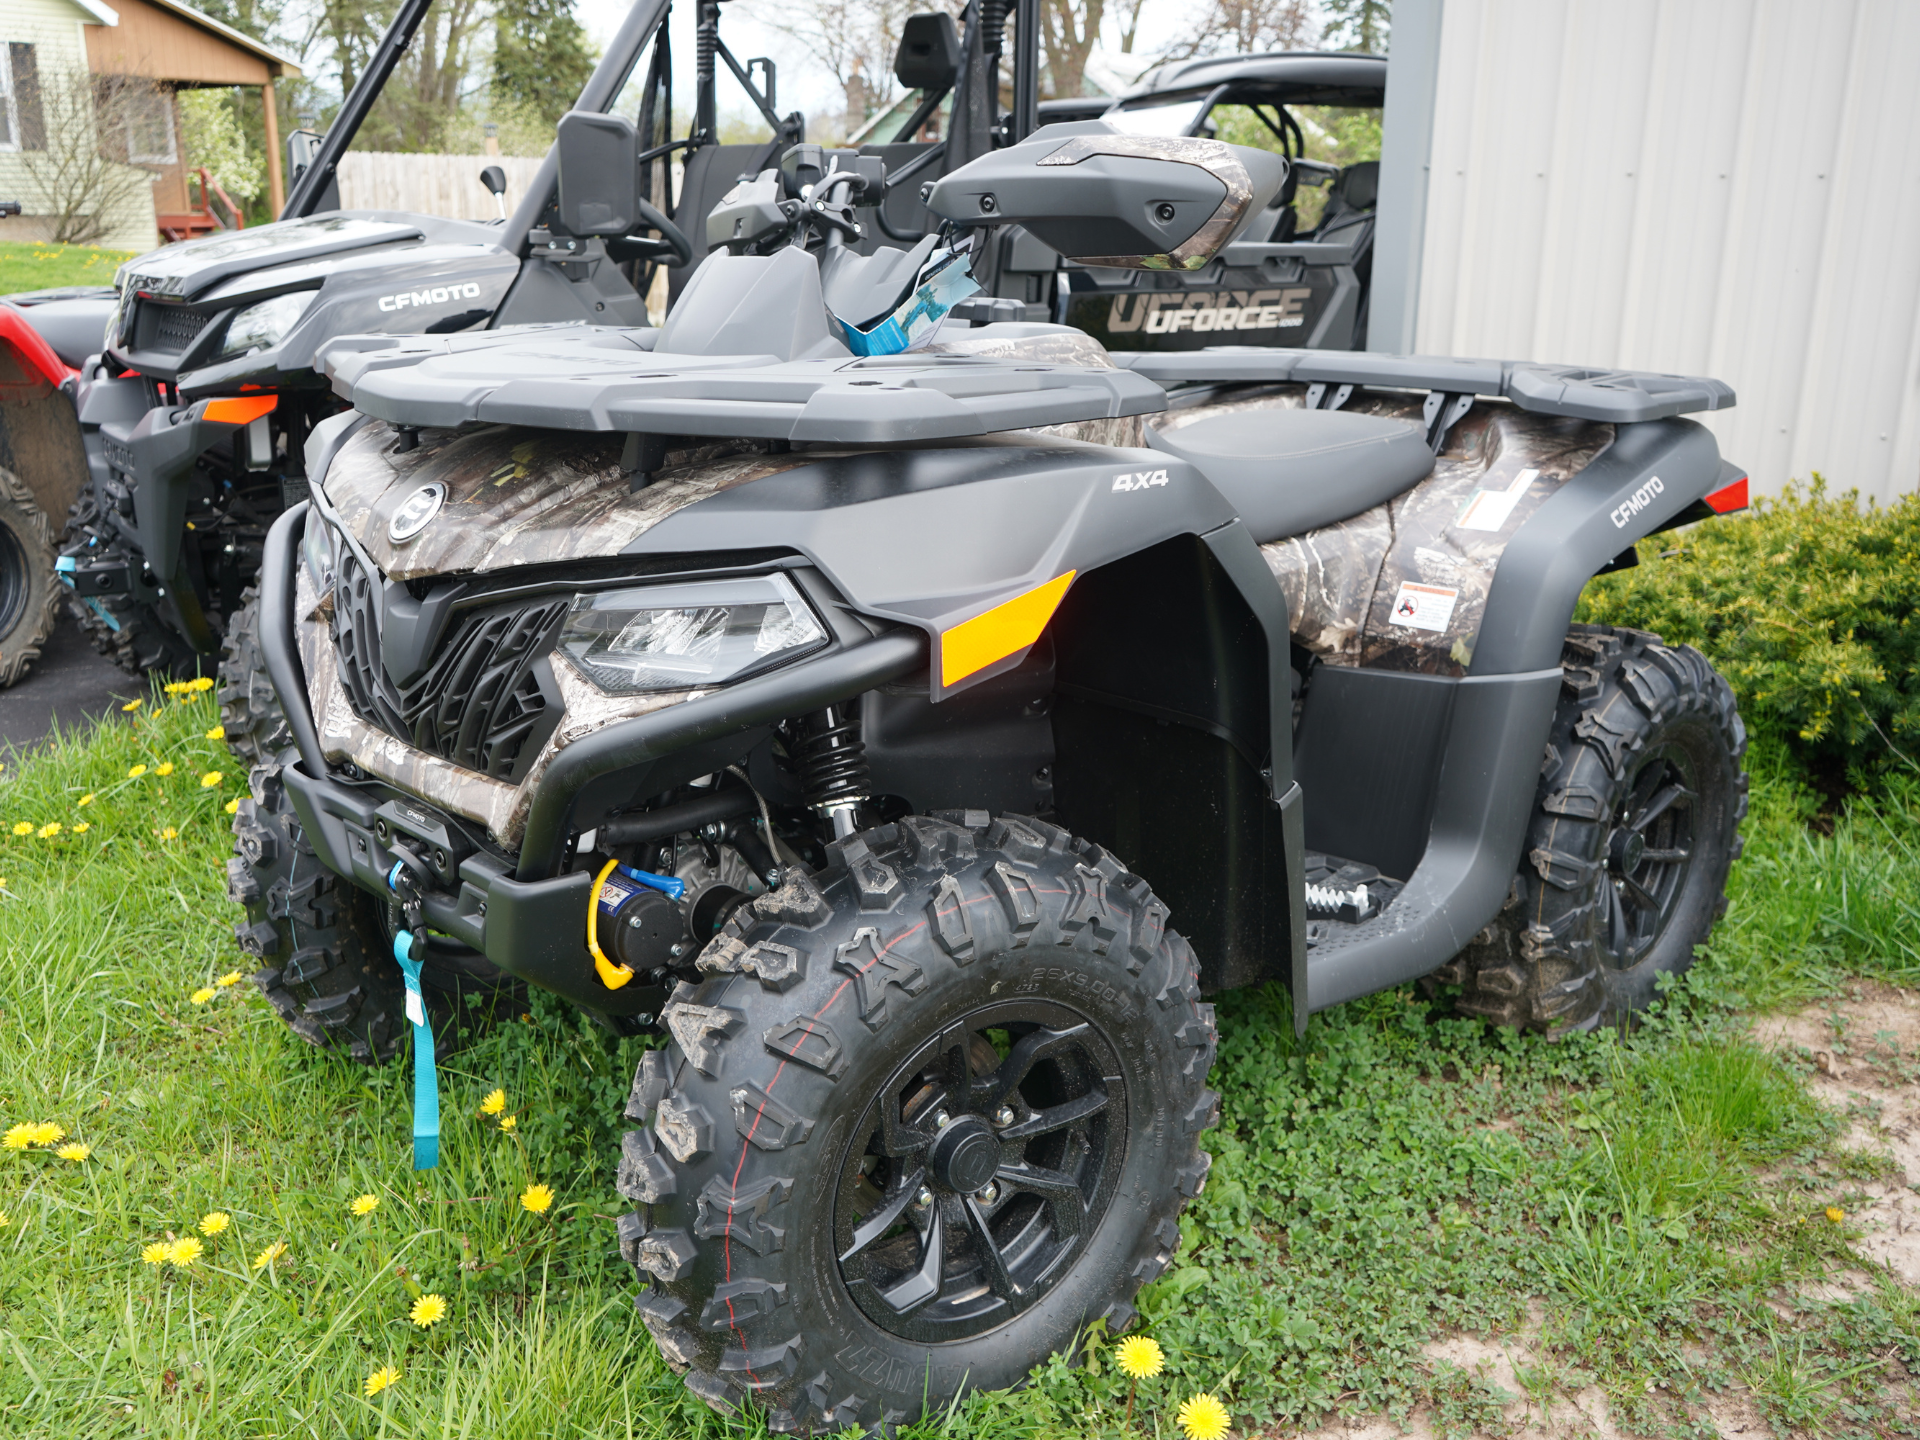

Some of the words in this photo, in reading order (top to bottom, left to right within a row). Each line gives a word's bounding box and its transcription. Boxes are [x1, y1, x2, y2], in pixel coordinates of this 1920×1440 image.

[378, 282, 480, 312] CFMOTO
[1146, 305, 1283, 334] UFORCE
[1112, 469, 1169, 492] 4X4
[1610, 475, 1665, 529] CFMOTO
